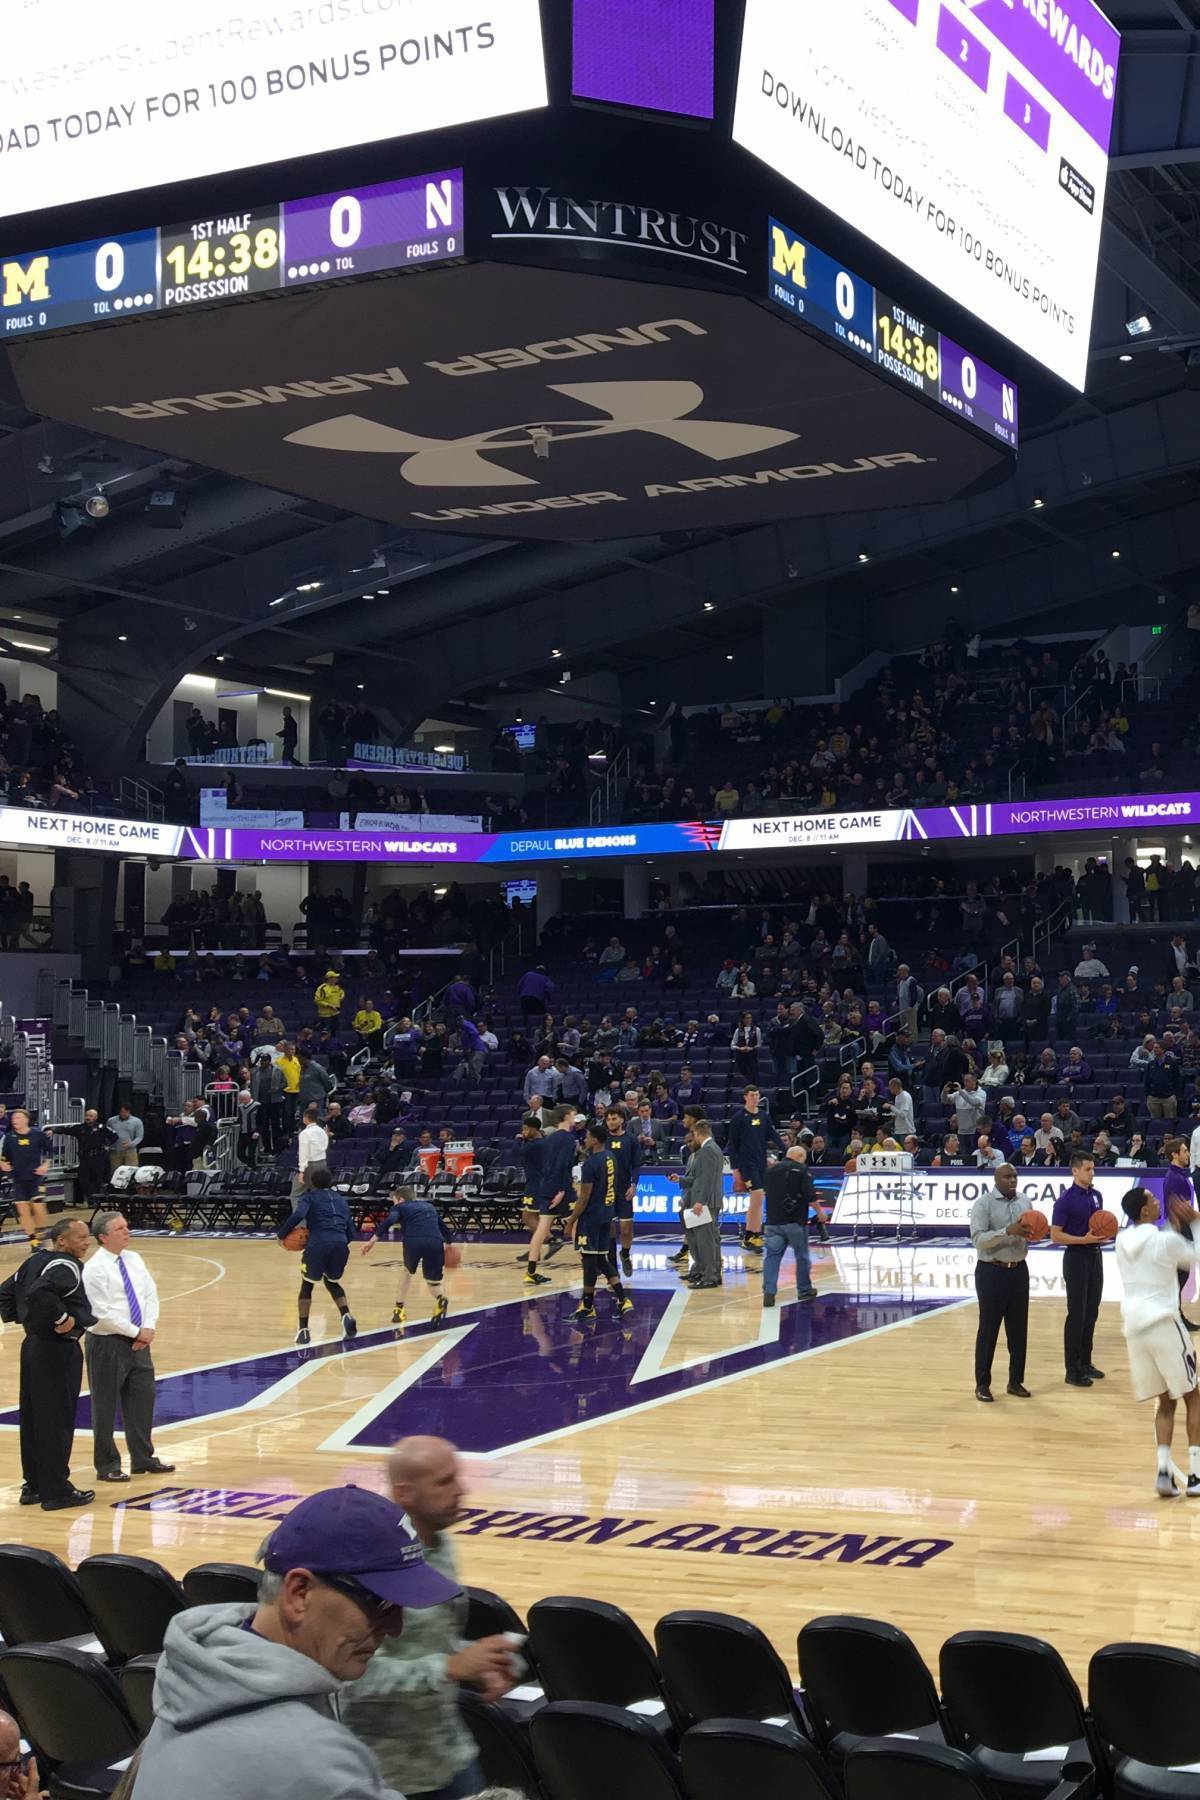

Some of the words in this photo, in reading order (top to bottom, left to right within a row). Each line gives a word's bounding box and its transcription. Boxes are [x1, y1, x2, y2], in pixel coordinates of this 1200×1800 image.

[959, 39, 969, 62] 2
[0, 124, 40, 152] AD
[47, 101, 136, 142] TODAY
[145, 88, 200, 122] FOR
[208, 75, 257, 108] 100
[266, 50, 370, 95] BONUS
[379, 22, 495, 71] POINTS
[1023, 103, 1031, 124] 3
[425, 179, 452, 229] N
[761, 69, 868, 170] DOWNLOAD
[872, 156, 925, 214] TODAY
[927, 203, 956, 241] FOR
[960, 228, 982, 261] 100
[985, 249, 1030, 300] BONUS
[1032, 293, 1076, 335] POINTS
[191, 219, 212, 240] 1ST
[217, 213, 251, 238] HALF
[329, 195, 362, 248] 0
[166, 228, 279, 284] 14:38
[406, 240, 439, 258] FOULS
[447, 239, 456, 252] 0
[772, 226, 807, 289] M
[95, 241, 125, 291] 0
[335, 257, 355, 270] TOL
[3, 256, 50, 307] M
[165, 275, 248, 305] POSSESSION
[774, 284, 795, 306] FOULS
[835, 271, 855, 320] 0
[6, 315, 33, 330] FOULS
[39, 312, 47, 326] 0
[93, 301, 111, 314] TOL
[892, 306, 905, 324] 1ST
[906, 314, 925, 338] HALF
[424, 319, 708, 377] UNDER
[878, 315, 939, 381] 14:38
[878, 349, 924, 390] POSSESSION
[961, 356, 977, 400] 0
[1002, 383, 1014, 424] N
[410, 490, 628, 521] UNDER
[752, 821, 791, 835] NEXT
[794, 818, 835, 832] HOME
[839, 815, 882, 829] GAME
[1010, 806, 1119, 824] NORTHWESTERN
[1121, 802, 1192, 818] WILDCATS
[28, 815, 68, 832] NEXT
[72, 821, 115, 836] HOME
[119, 825, 160, 840] GAME
[67, 836, 84, 844] DEC.
[108, 839, 120, 847] AM
[788, 834, 804, 843] DEC.
[828, 832, 839, 840] AM
[260, 838, 382, 853] NORTHWESTERN
[384, 841, 457, 854] WILDCATS
[511, 839, 553, 853] DEPAUL
[555, 837, 584, 851] BLUE
[586, 834, 637, 848] DEMONS
[632, 1195, 667, 1213] LUE
[876, 1182, 938, 1201] NEXT
[945, 1182, 990, 1201] HOM
[1023, 1182, 1074, 1202] GAM
[936, 1208, 964, 1218] DEC.
[628, 1523, 957, 1569] ARENA
